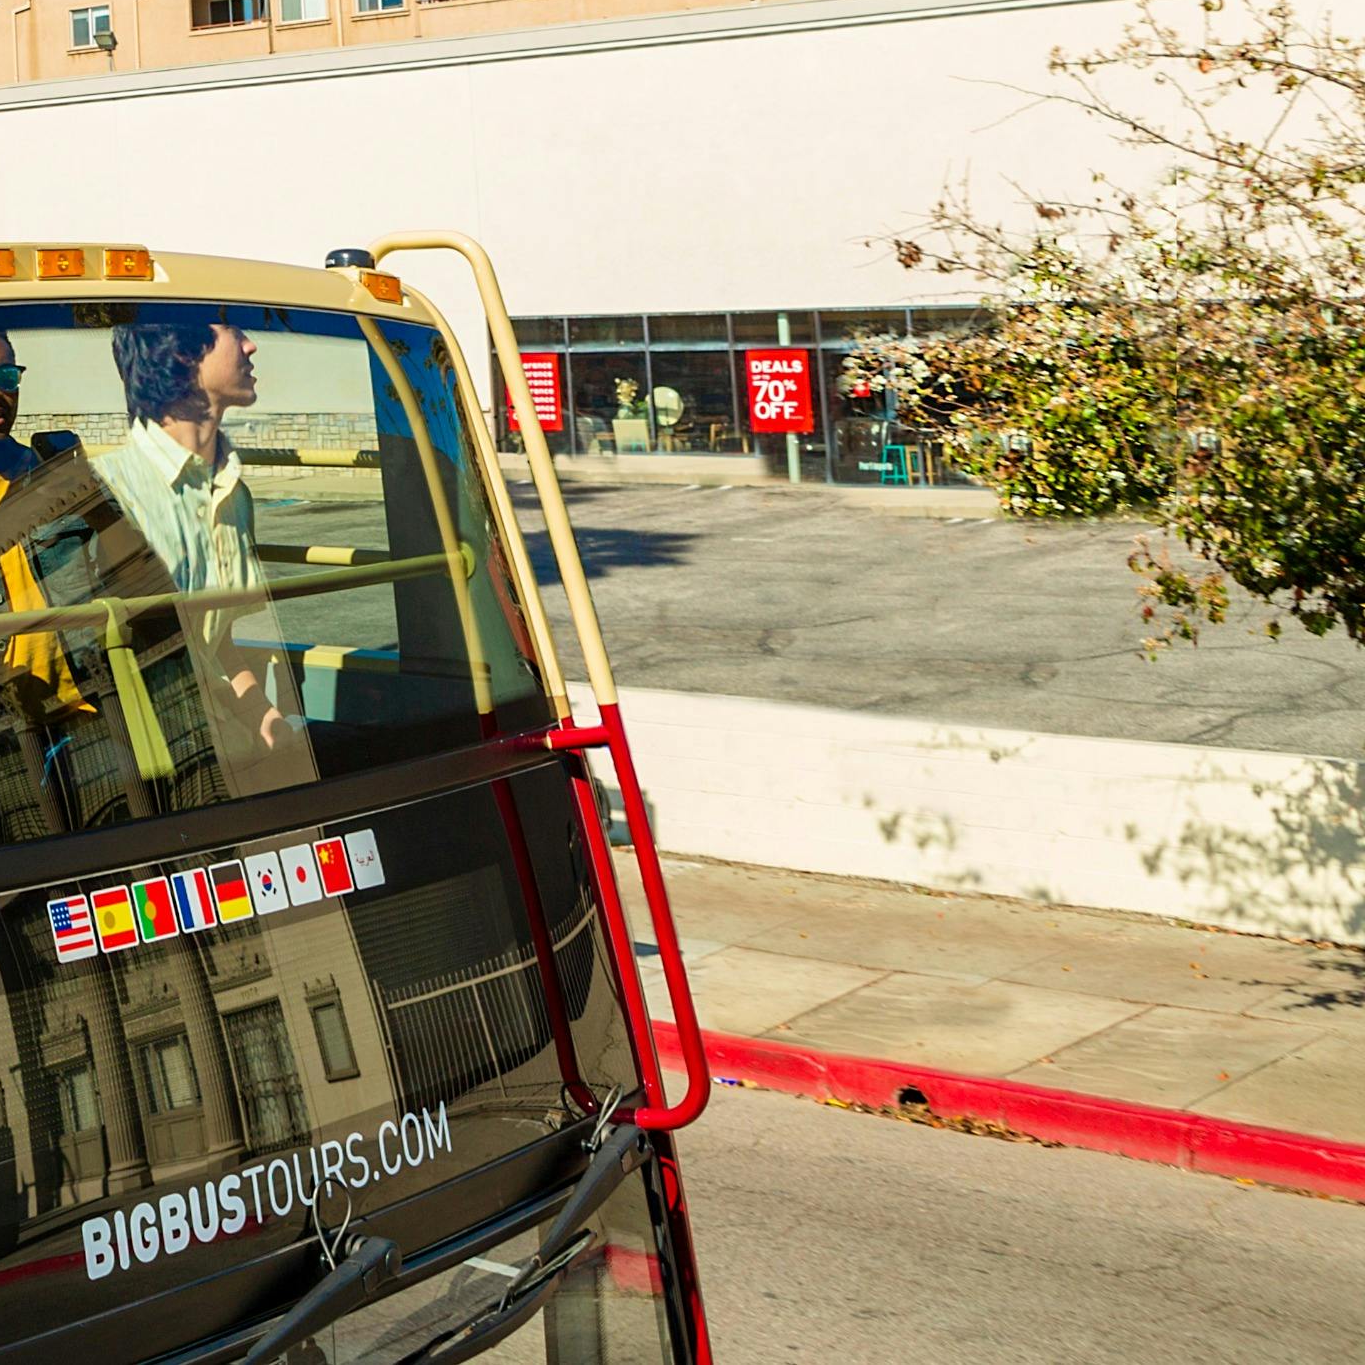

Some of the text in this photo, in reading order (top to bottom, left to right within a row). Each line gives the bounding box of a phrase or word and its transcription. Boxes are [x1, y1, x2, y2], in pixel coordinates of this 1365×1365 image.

[750, 360, 804, 374] DEALS
[752, 379, 798, 403] 70%
[754, 401, 799, 420] OFF
[80, 1100, 453, 1282] BIGBUSTOURS.COM
